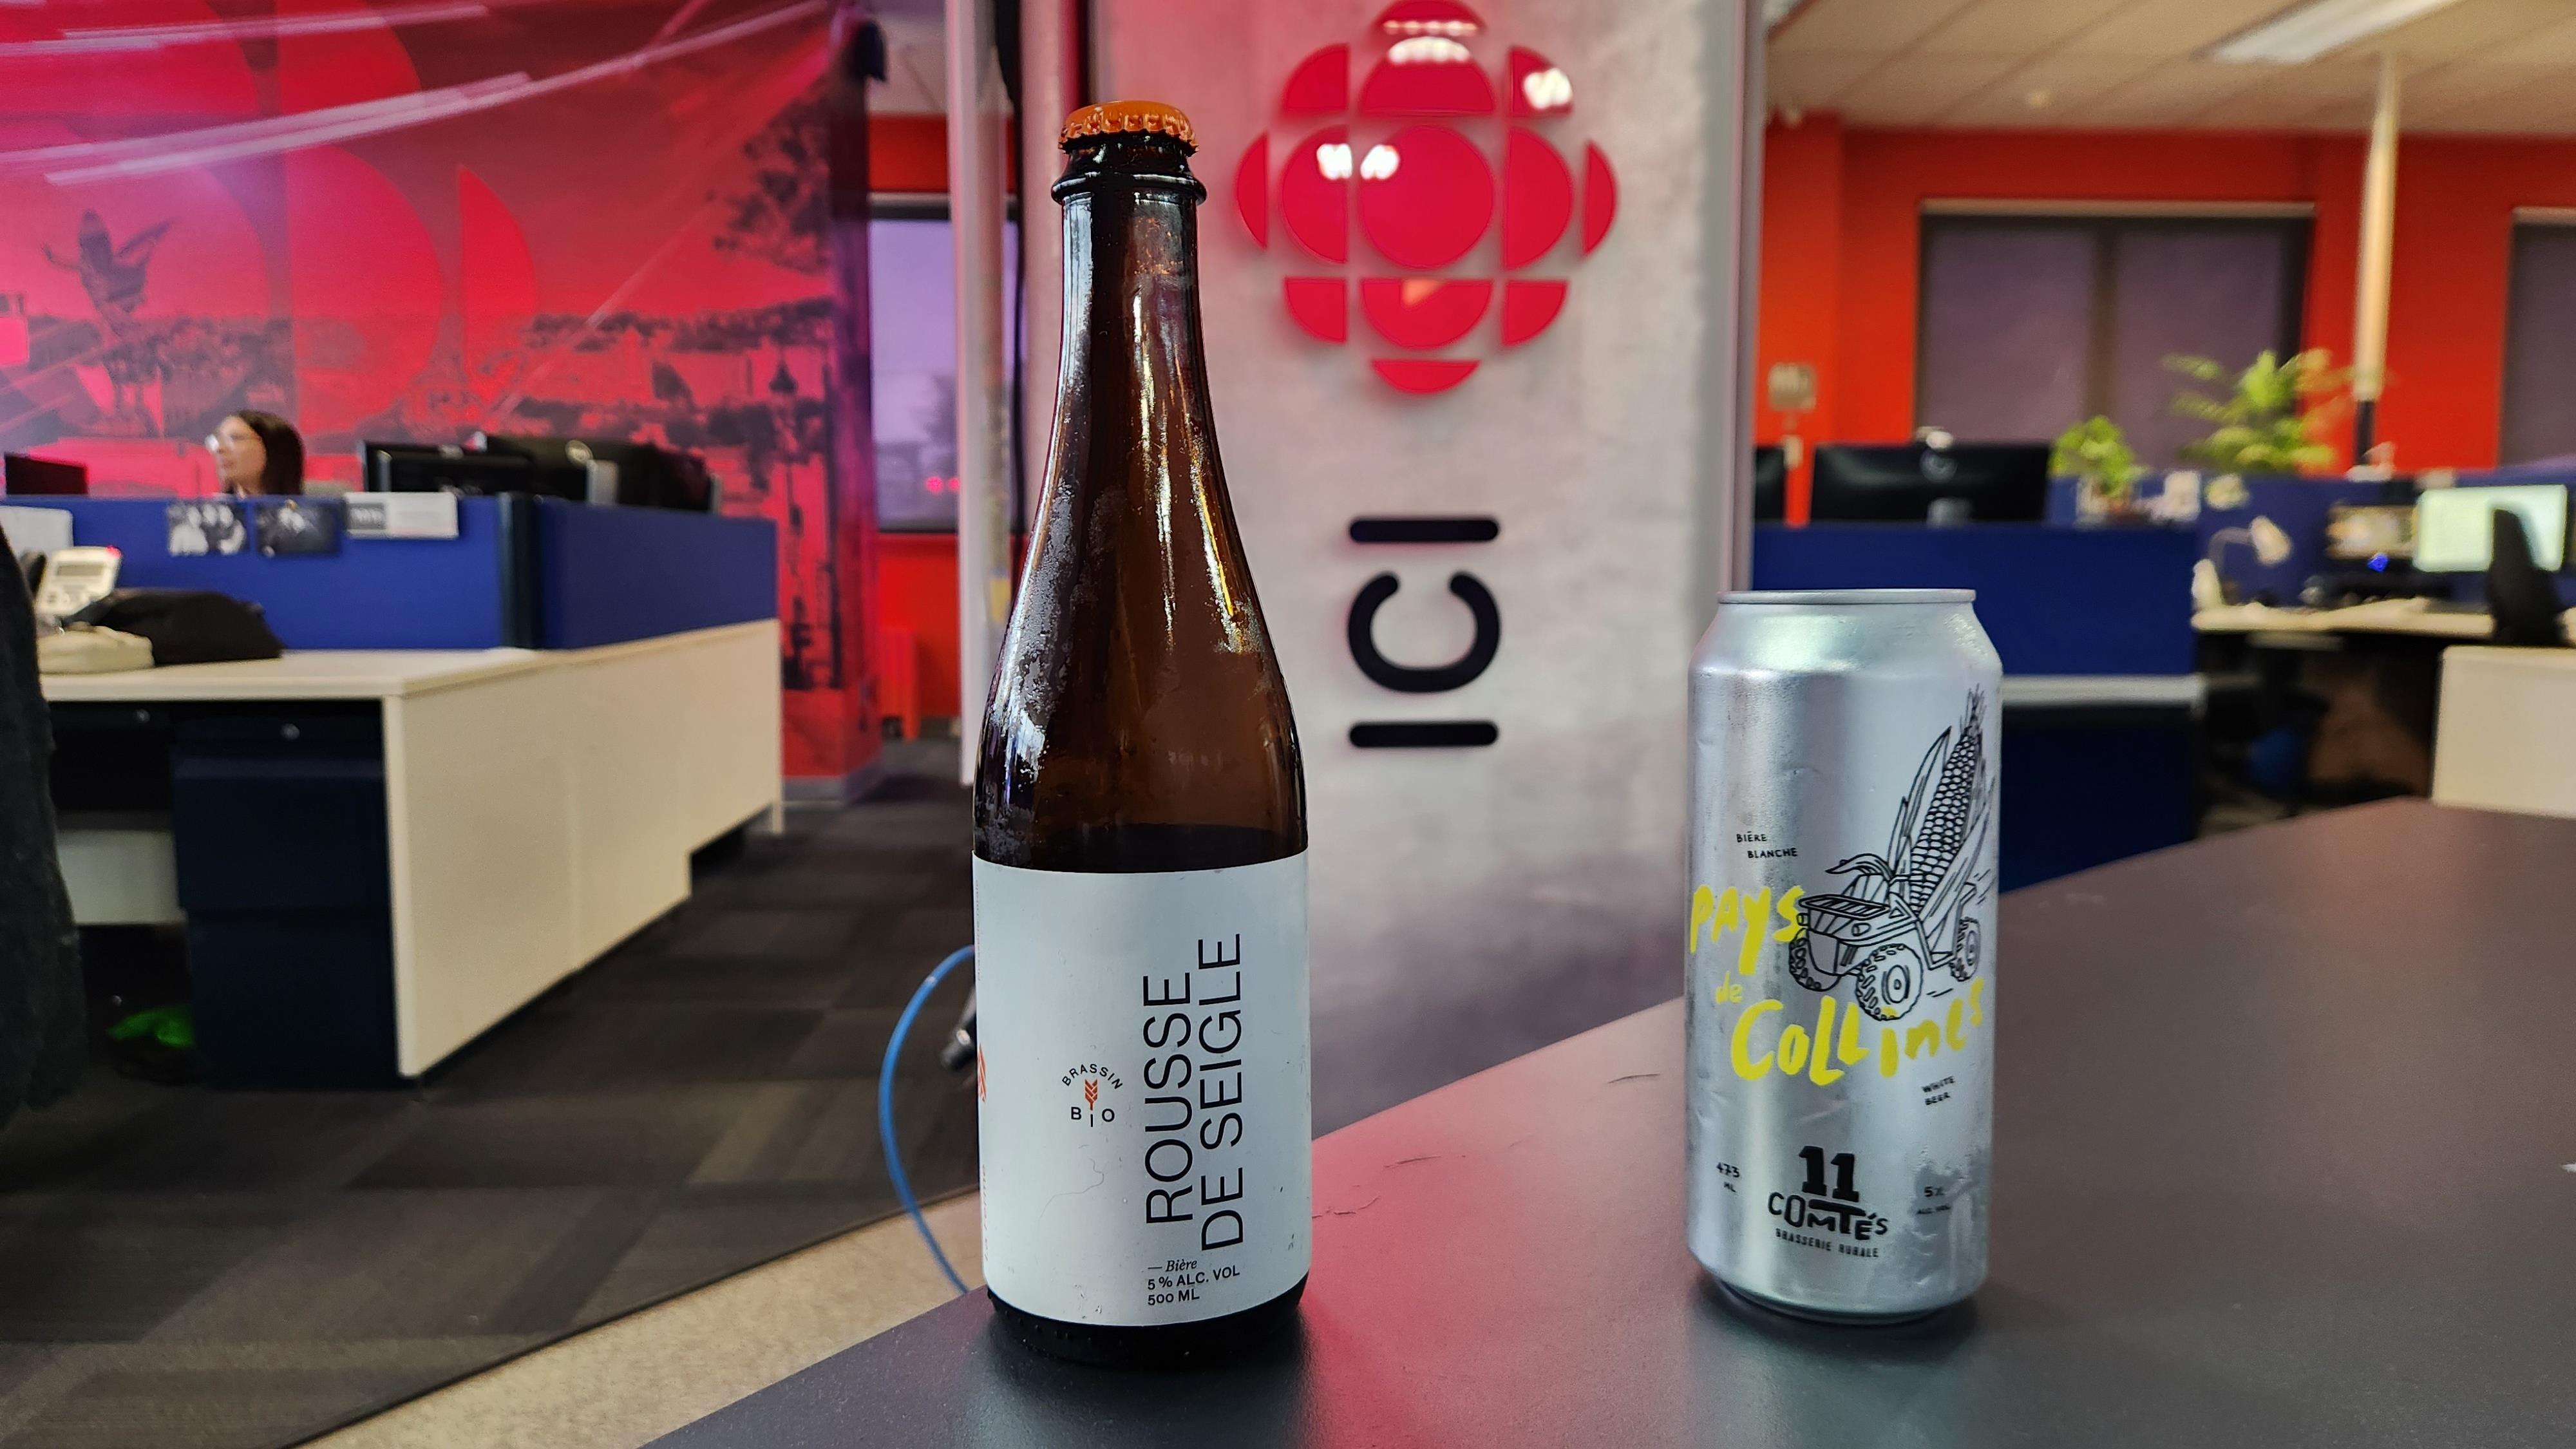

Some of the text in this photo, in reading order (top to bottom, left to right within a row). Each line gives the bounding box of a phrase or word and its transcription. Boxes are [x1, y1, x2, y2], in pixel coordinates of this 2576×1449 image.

[1349, 519, 1501, 748] ICI
[1736, 831, 1768, 843] BIÈRE
[1747, 848, 1799, 859] BLANCHE
[1061, 1063, 1123, 1090] BRASSIN
[1143, 972, 1195, 1224] ROUSSE
[1198, 933, 1244, 1251] DE SEIGLE
[1071, 1106, 1115, 1128] BIO
[1716, 1162, 1741, 1178] 473
[1799, 1146, 1859, 1202] 11
[1776, 1227, 1879, 1258] BRASSERIE RURALE
[1165, 1258, 1198, 1272] Bière
[1176, 1271, 1209, 1287] ALC.
[1213, 1265, 1240, 1281] VOL
[1147, 1288, 1200, 1305] 500 ML
